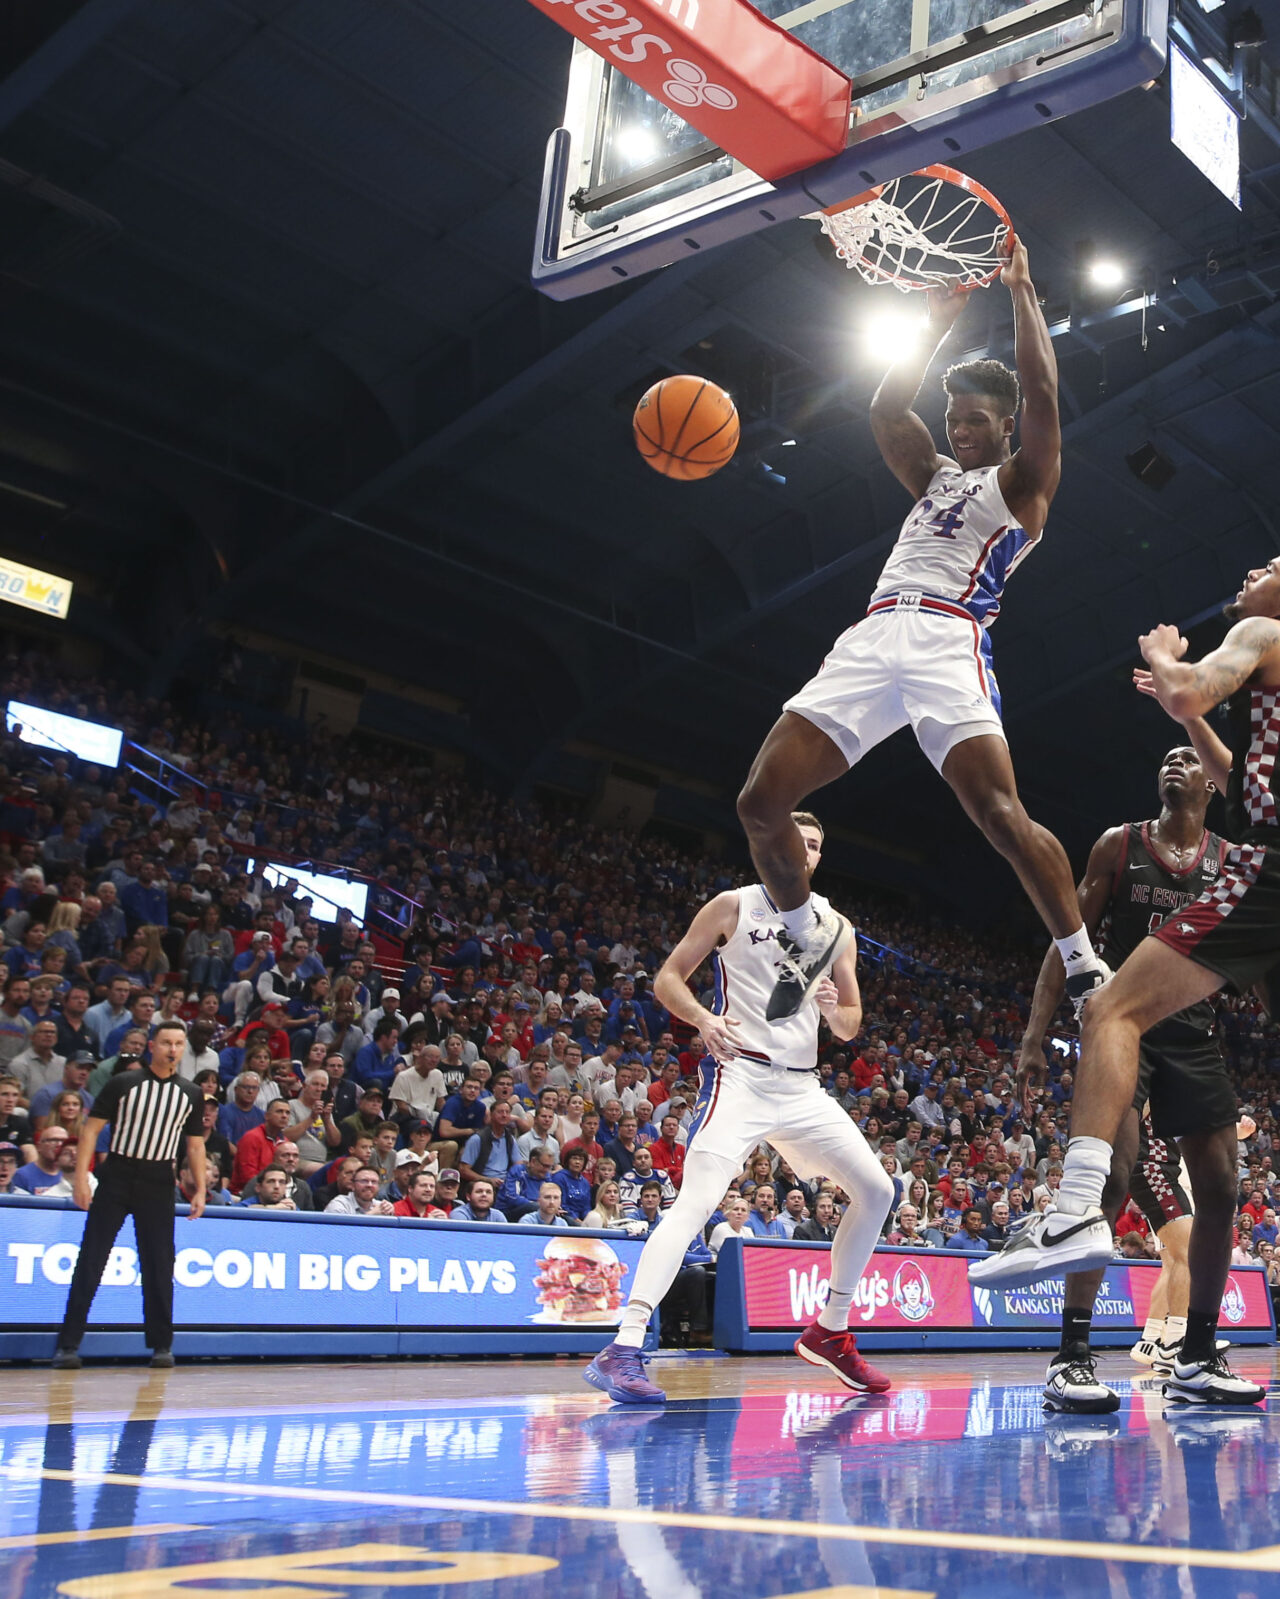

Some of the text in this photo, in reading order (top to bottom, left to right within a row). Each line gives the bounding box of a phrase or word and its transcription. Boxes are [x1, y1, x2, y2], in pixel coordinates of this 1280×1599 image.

[900, 595, 918, 606] KU
[1130, 883, 1195, 908] NC CENTR
[8, 1243, 517, 1294] TO BCON BIG PLAYS
[788, 1264, 891, 1322] Wey's
[1030, 1280, 1065, 1296] UNIVE
[1004, 1295, 1049, 1314] KANSAS
[1094, 1298, 1133, 1315] SYSTEM
